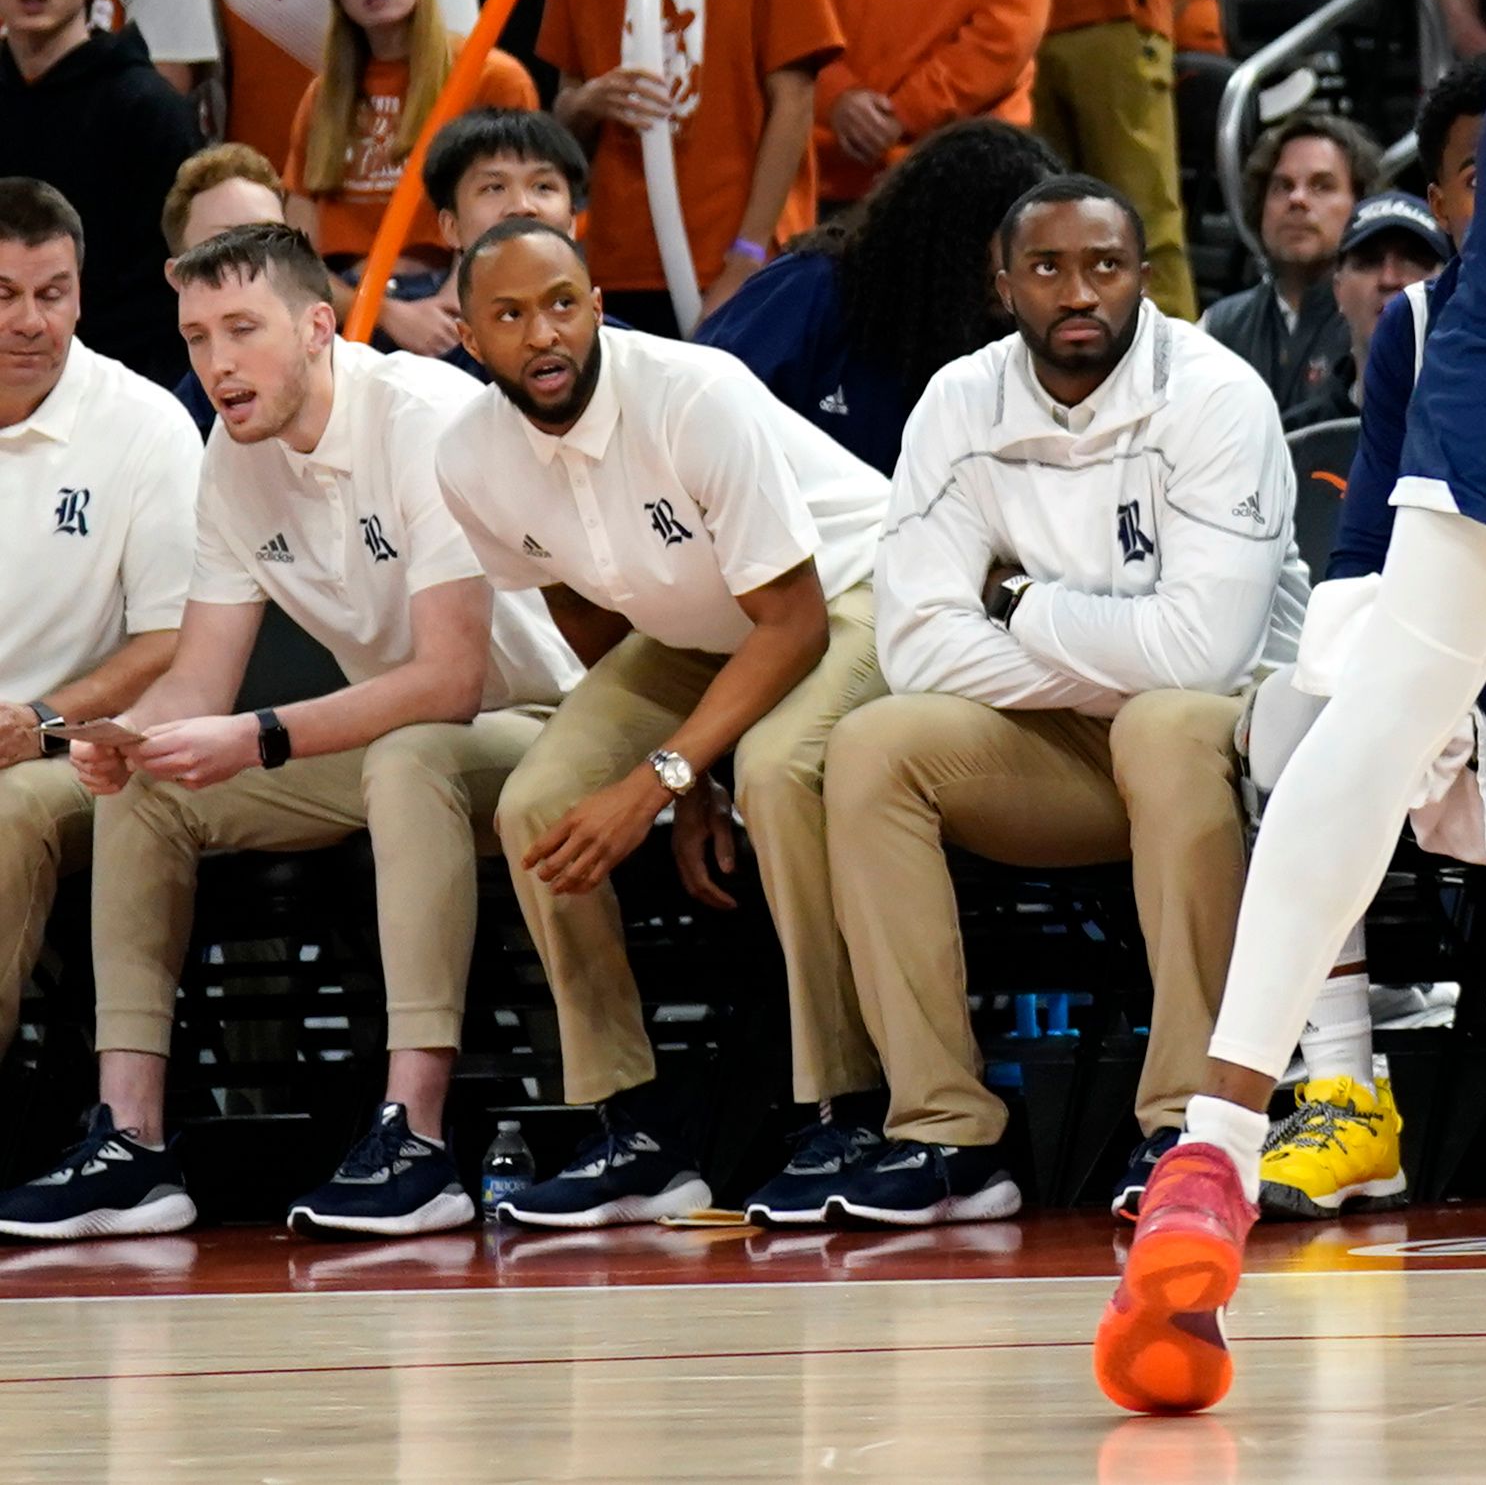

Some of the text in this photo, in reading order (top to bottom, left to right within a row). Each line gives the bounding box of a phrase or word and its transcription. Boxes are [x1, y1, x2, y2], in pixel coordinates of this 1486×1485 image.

[53, 487, 91, 537] R
[644, 497, 693, 548] R
[1116, 498, 1155, 567] R
[359, 514, 398, 564] R
